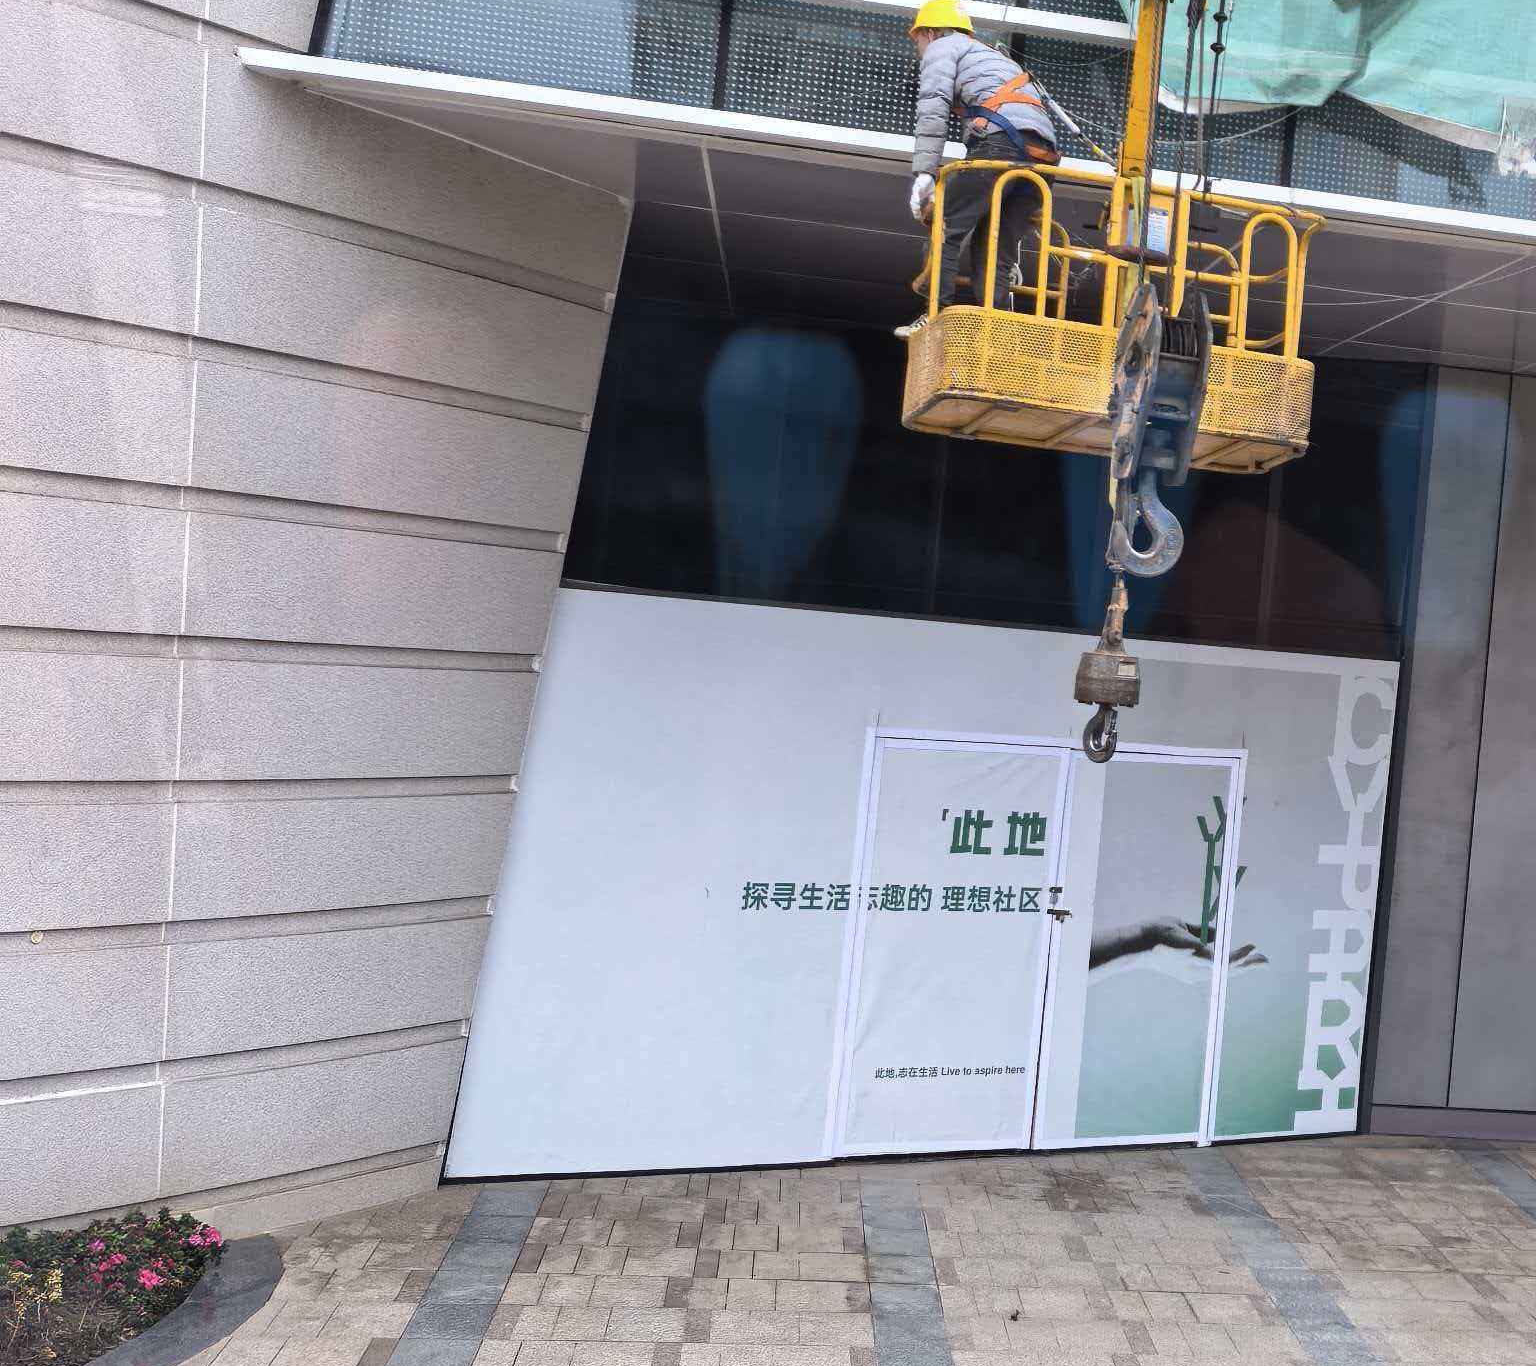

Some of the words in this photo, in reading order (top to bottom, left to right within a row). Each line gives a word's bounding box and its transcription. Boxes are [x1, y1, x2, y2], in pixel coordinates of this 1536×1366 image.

[941, 1067, 960, 1076] Live
[963, 1067, 972, 1076] to
[974, 1066, 1003, 1077] aspire
[1005, 1065, 1026, 1074] here
